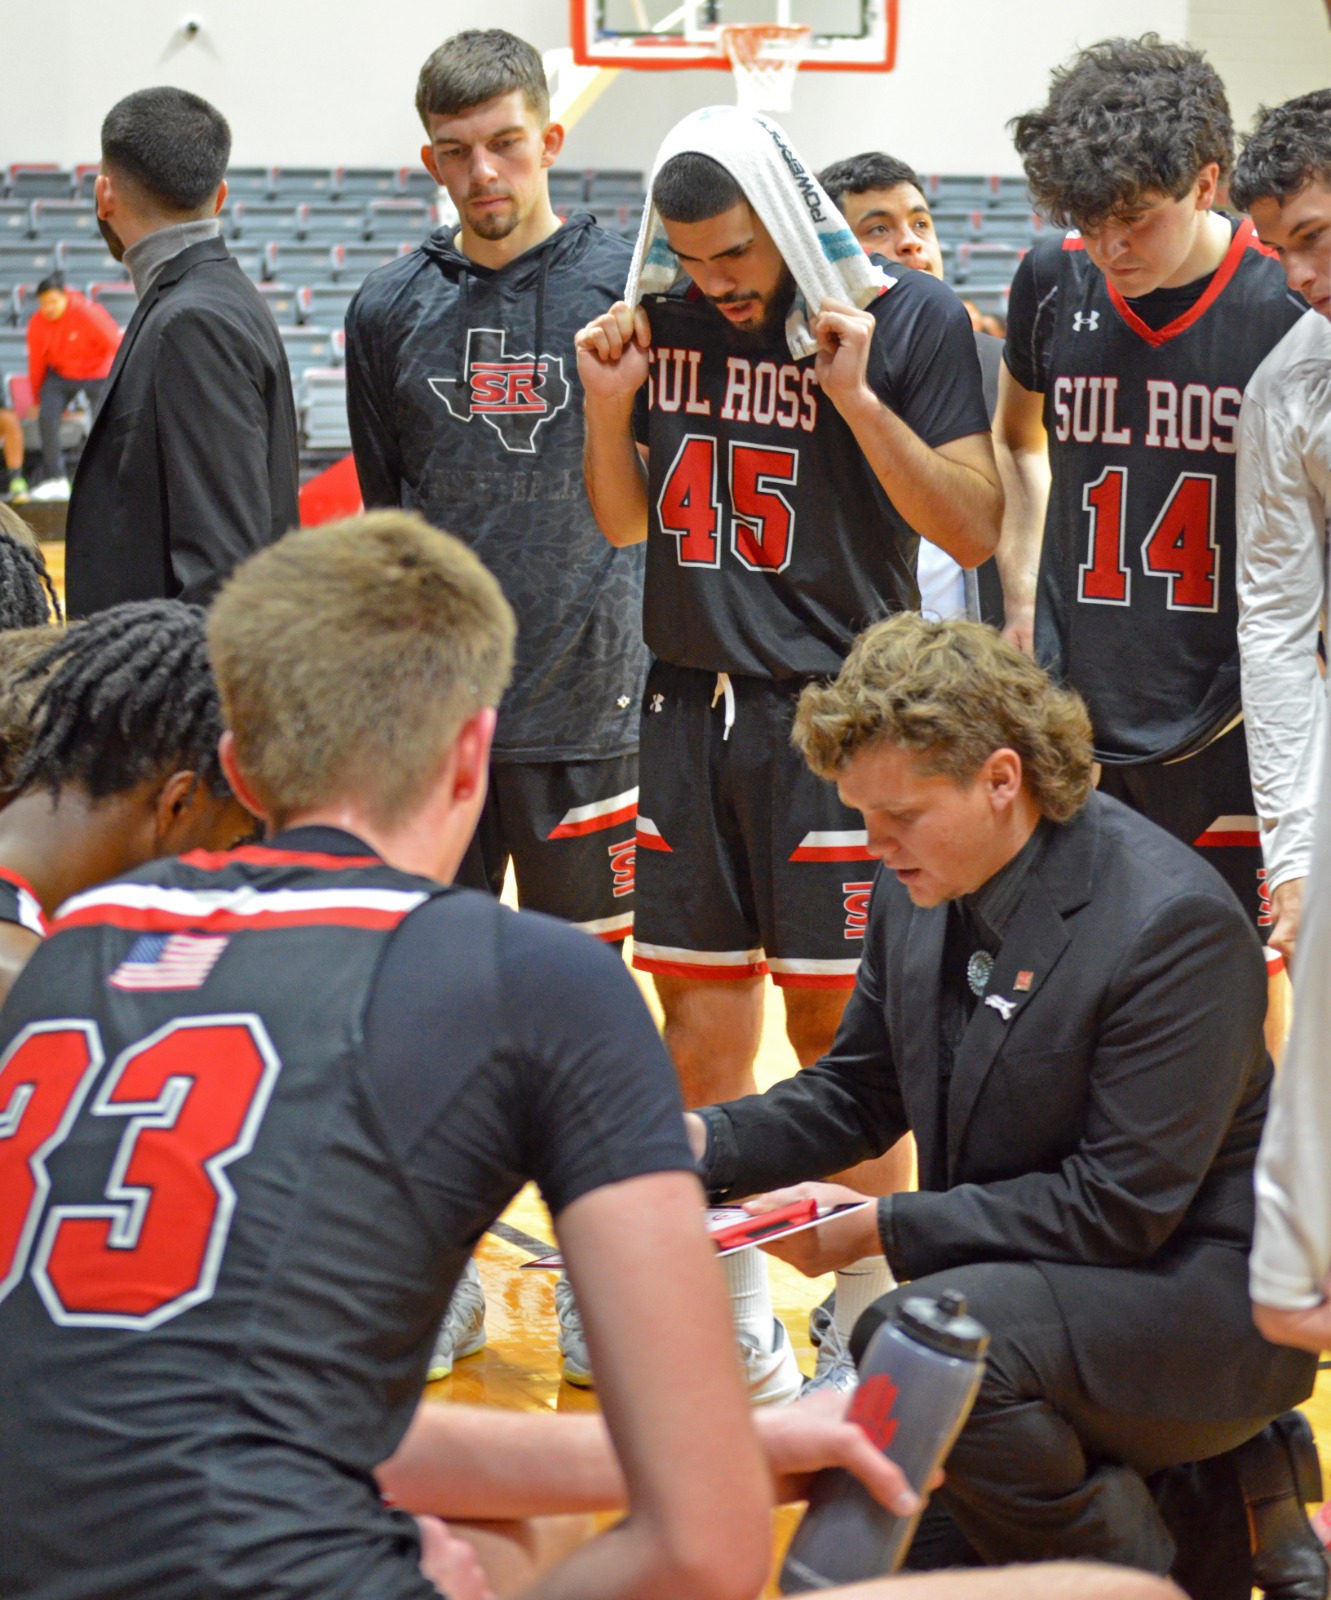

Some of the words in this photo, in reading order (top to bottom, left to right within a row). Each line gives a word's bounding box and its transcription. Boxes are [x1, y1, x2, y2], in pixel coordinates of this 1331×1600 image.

[752, 117, 828, 223] POWERA
[470, 371, 548, 405] SR
[648, 347, 711, 415] UL
[720, 356, 819, 432] ROSS
[1054, 374, 1131, 445] SUL
[1145, 379, 1242, 454] ROS
[656, 433, 799, 574] 45
[1077, 465, 1220, 613] 14
